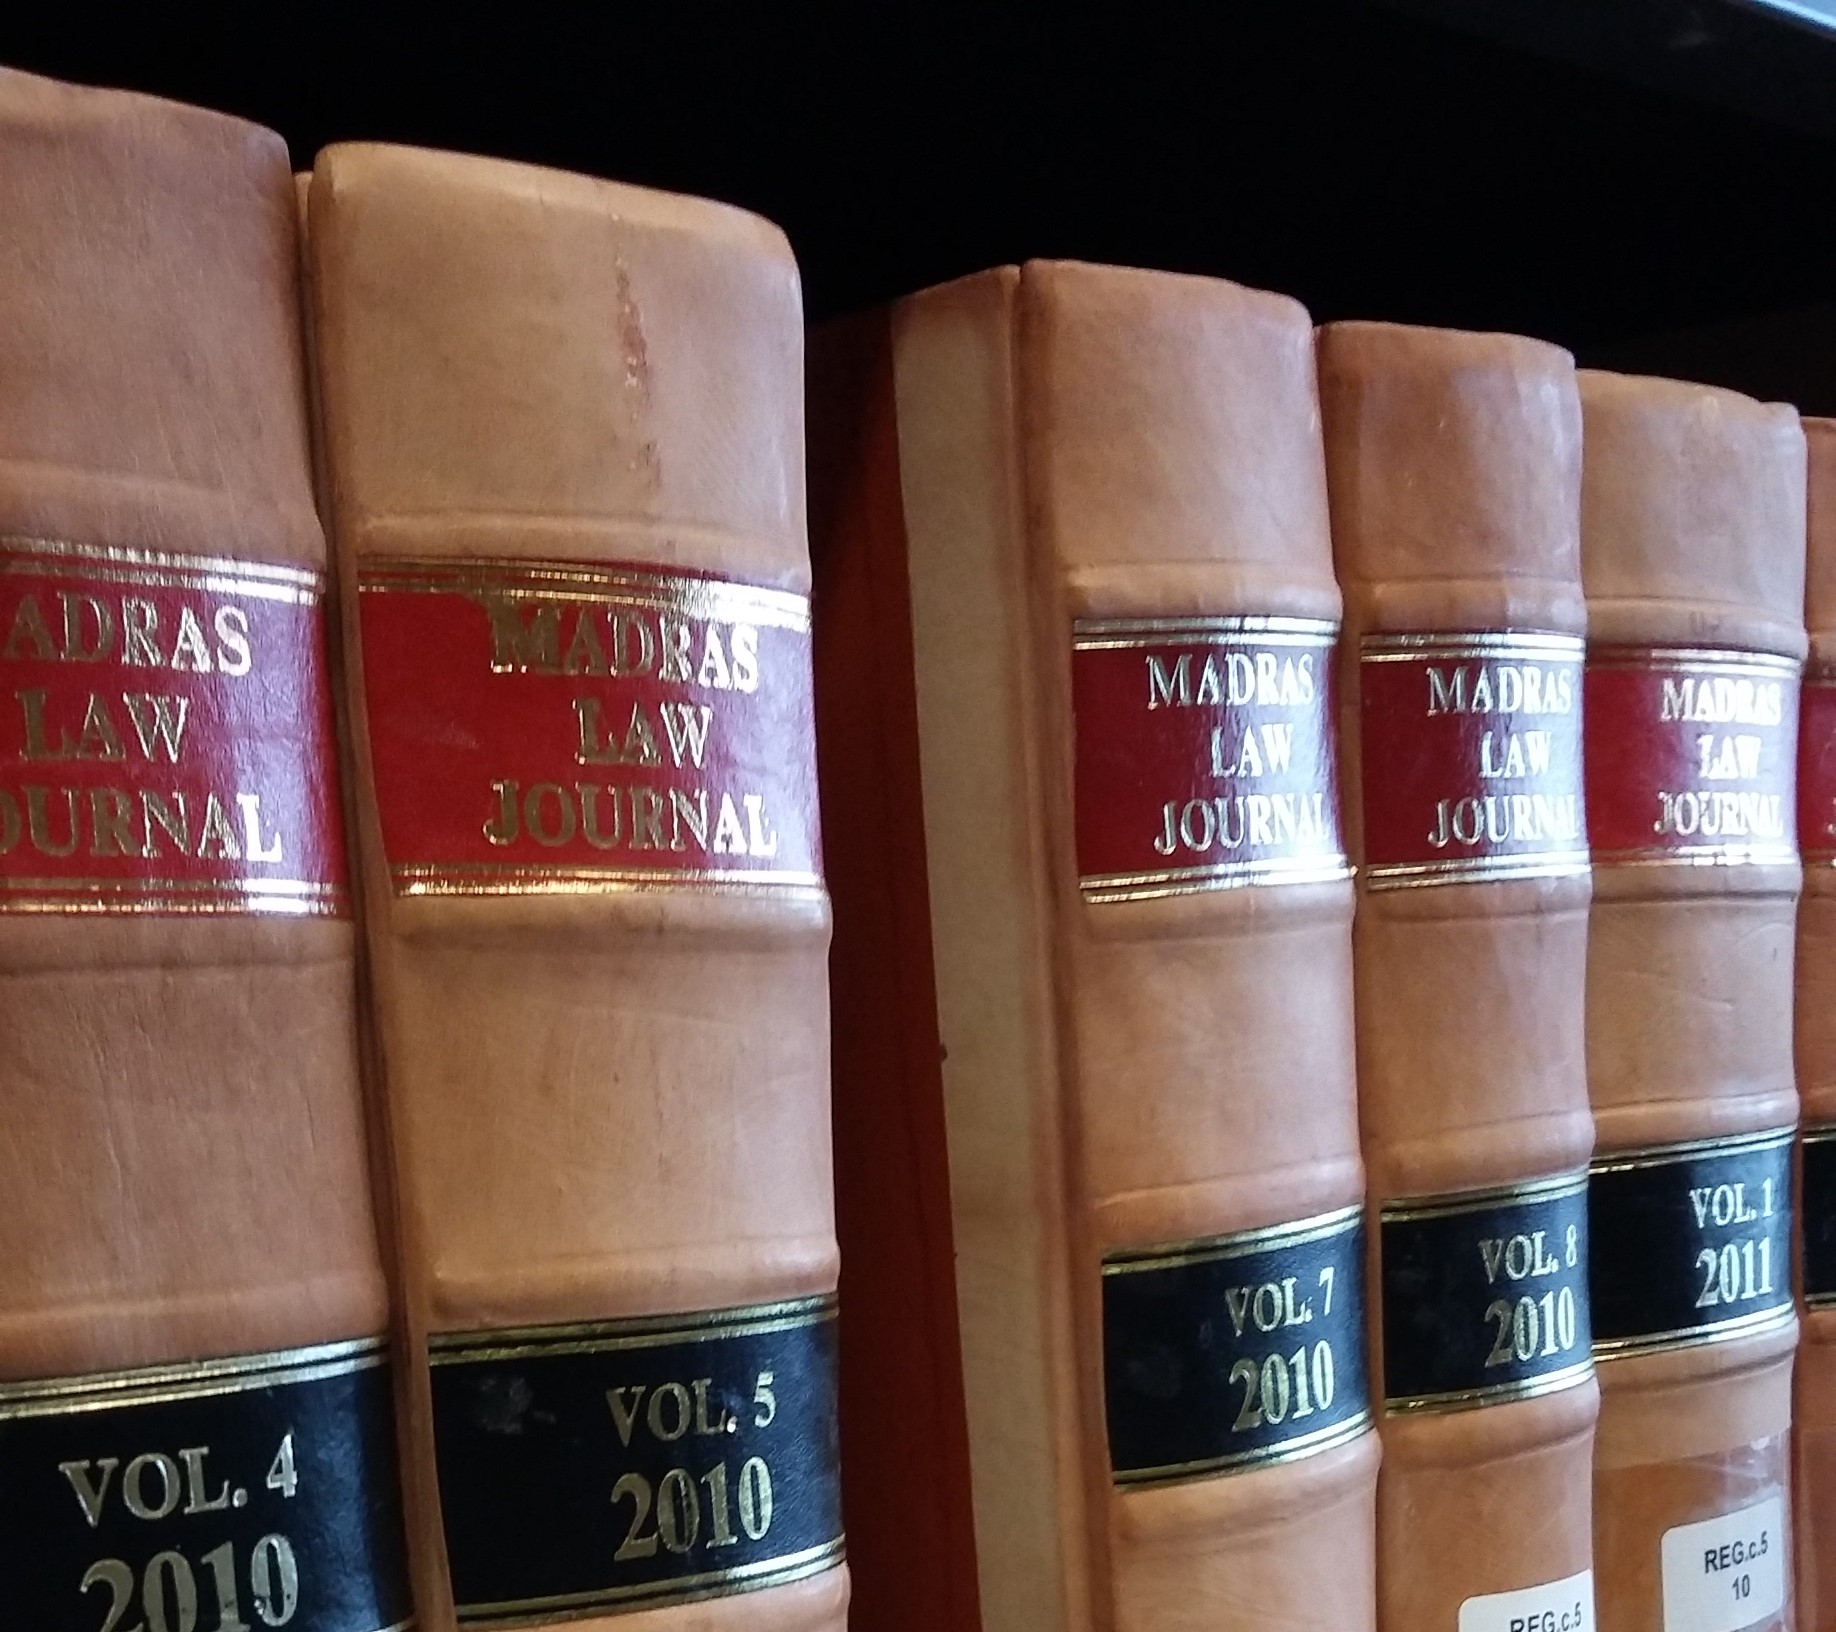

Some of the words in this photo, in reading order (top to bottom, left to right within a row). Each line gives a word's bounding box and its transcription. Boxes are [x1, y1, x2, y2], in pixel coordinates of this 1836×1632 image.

[0, 592, 254, 677] ADRAS
[487, 598, 760, 692] MADRAS
[1146, 653, 1314, 712] MADRAS
[1426, 666, 1572, 716] MADRAS
[1661, 677, 1782, 727] MADRAS
[15, 689, 190, 764] LAW
[574, 698, 714, 769] LAW
[1210, 723, 1294, 778] LAW
[1480, 730, 1552, 779] LAW
[1698, 733, 1762, 781] LAW
[0, 784, 283, 864] URNAL
[483, 779, 778, 859] JOURNAL
[1153, 792, 1329, 856] JOURNAL
[1426, 794, 1578, 847] JOURNAL
[1654, 792, 1784, 839] JOURNAL
[1689, 1183, 1758, 1230] VOL.
[1762, 1177, 1774, 1219] 1
[1478, 1232, 1560, 1285] VOL.
[1565, 1224, 1579, 1268] 8
[1694, 1238, 1773, 1309] 2011
[1224, 1281, 1313, 1338] VOL.
[1319, 1266, 1336, 1315] 7
[1484, 1287, 1578, 1369] 2010
[606, 1379, 738, 1448] VOL.
[752, 1371, 778, 1429] 5
[1228, 1340, 1336, 1434] 2010
[59, 1446, 249, 1529] VOL.
[265, 1432, 299, 1500] 4
[610, 1455, 776, 1562] 2010
[1703, 1530, 1770, 1575] REG.c.5
[1731, 1574, 1751, 1601] 10
